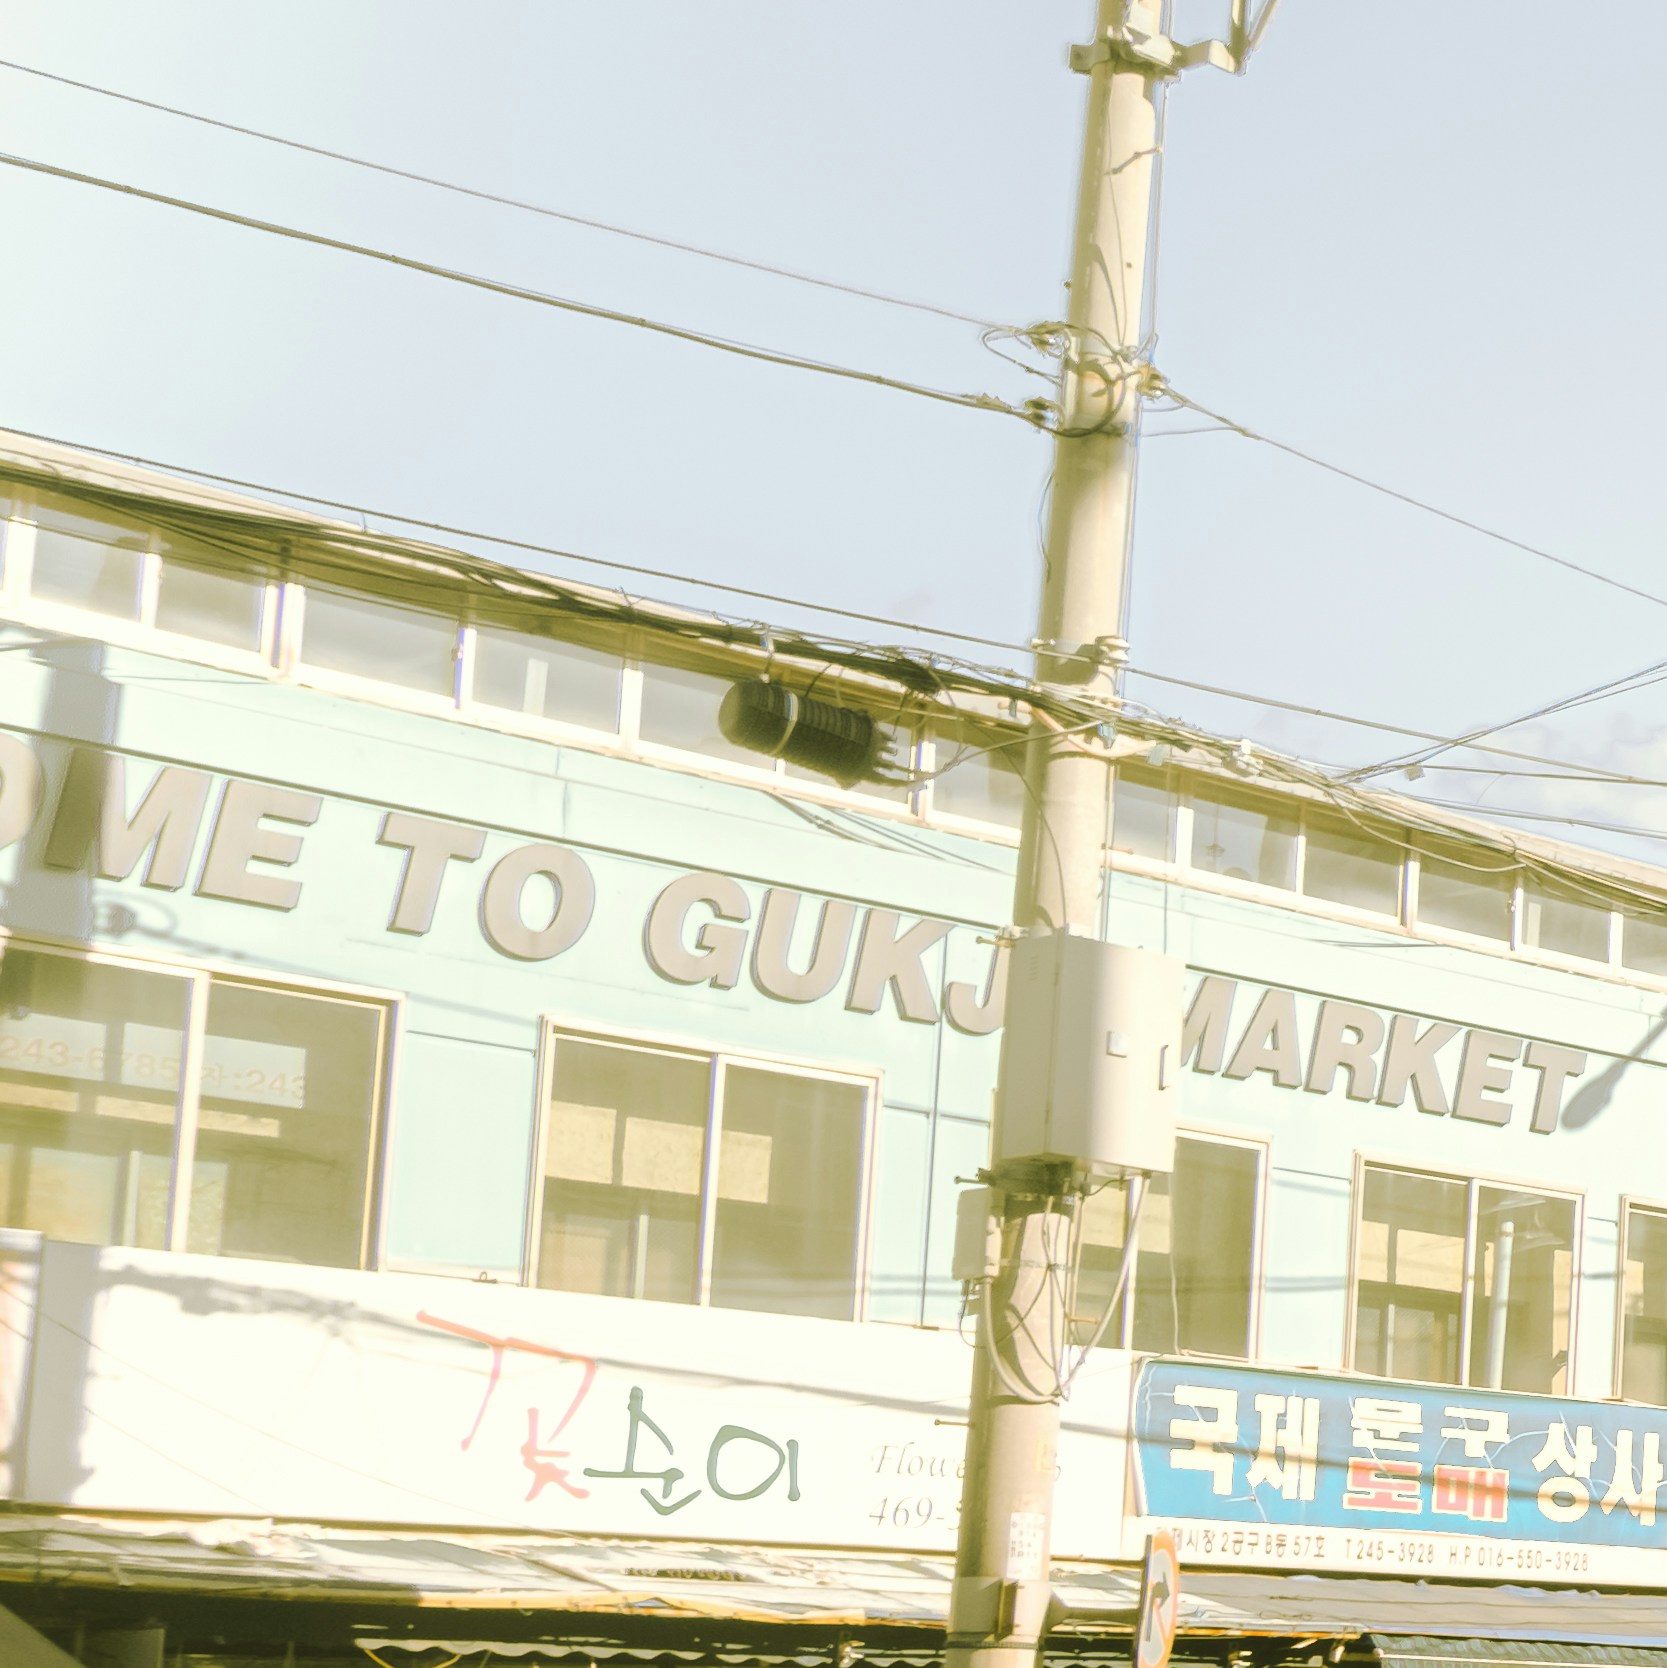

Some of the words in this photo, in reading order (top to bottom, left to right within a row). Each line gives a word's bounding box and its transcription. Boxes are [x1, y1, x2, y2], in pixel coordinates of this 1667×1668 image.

[375, 811, 596, 961] TO
[645, 872, 1006, 1037] GUKJ
[1170, 1385, 1320, 1502] 국제
[1351, 1398, 1510, 1459] 문구
[1531, 1421, 1665, 1527] 상사
[1342, 1456, 1510, 1524] 도매
[1221, 1531, 1260, 1557] 2공구
[1264, 1534, 1287, 1559] B동
[1293, 1535, 1326, 1561] 57호
[1476, 1546, 1589, 1573] 016-550-3928
